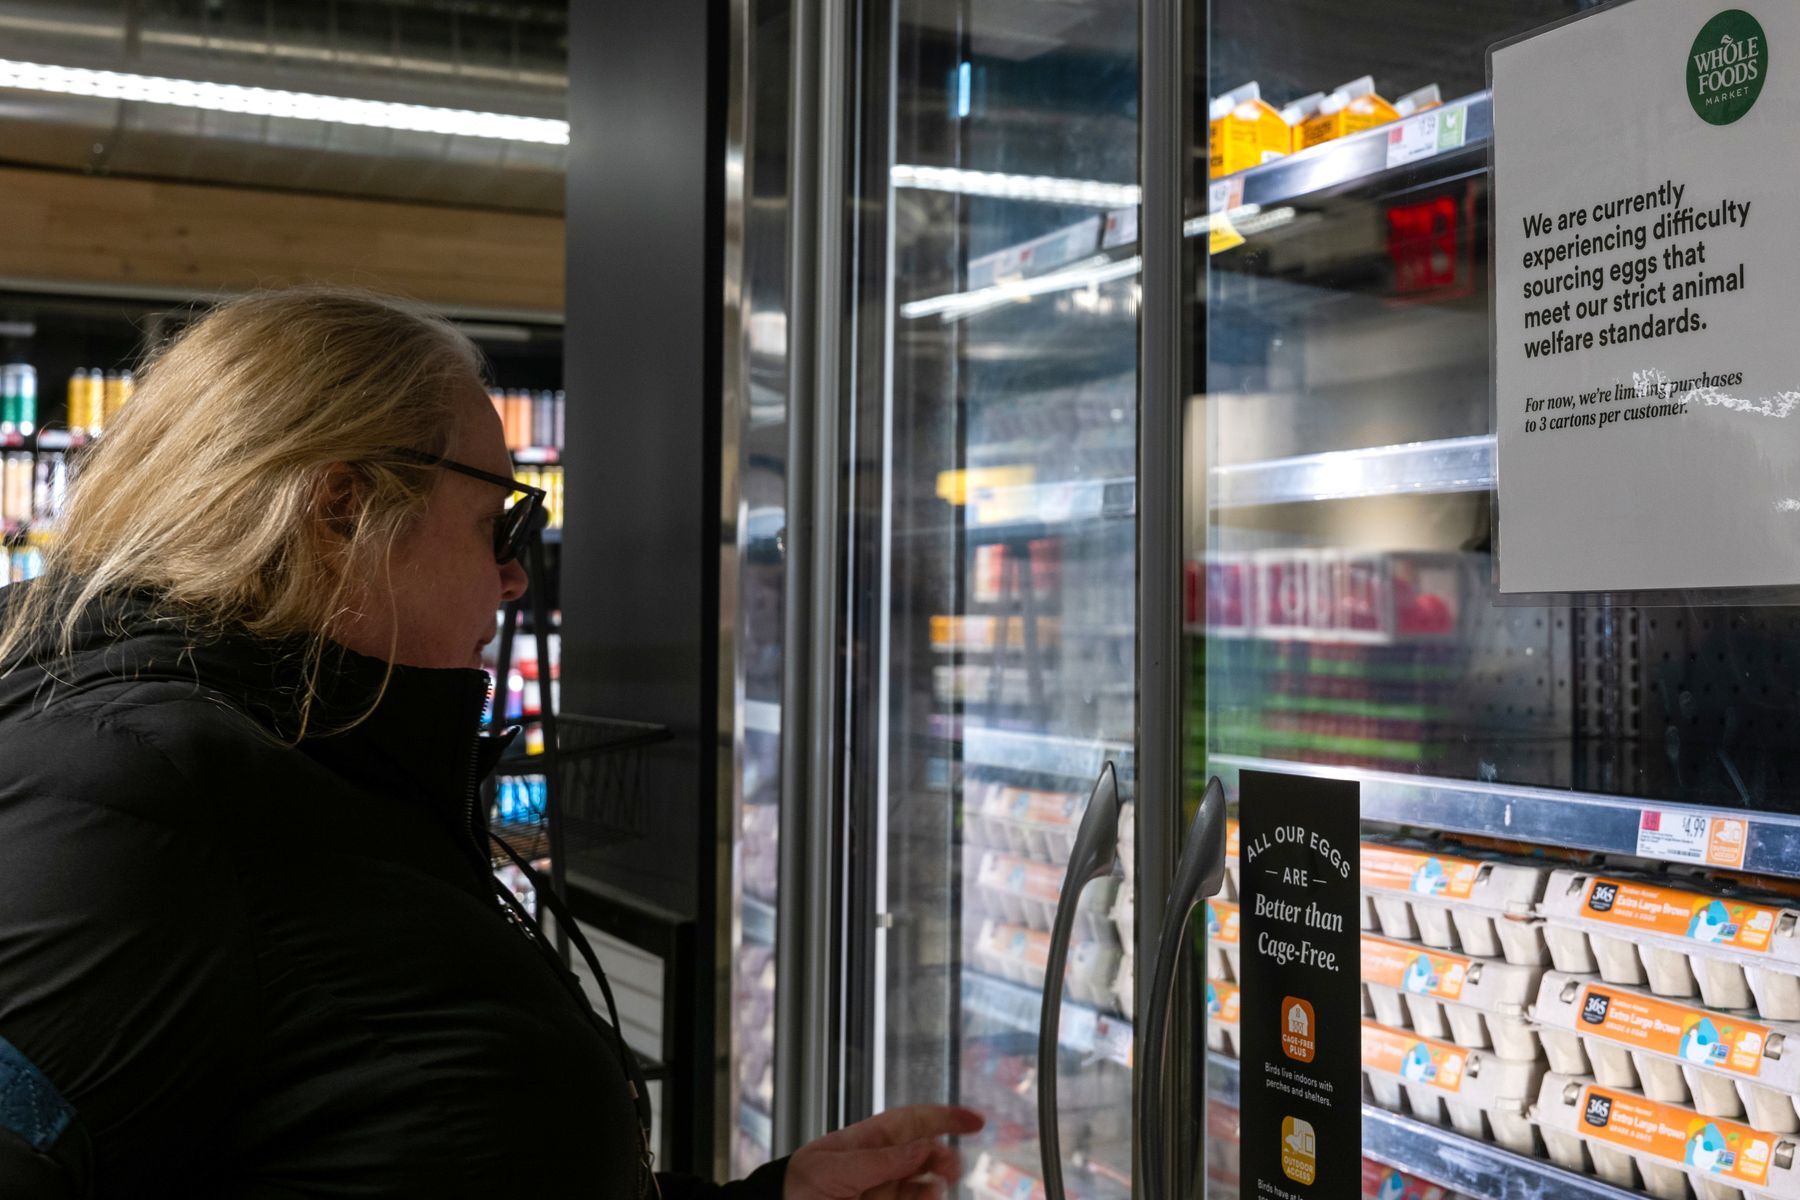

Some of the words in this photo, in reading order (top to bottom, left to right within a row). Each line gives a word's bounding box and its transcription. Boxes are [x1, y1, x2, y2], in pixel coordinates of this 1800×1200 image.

[1693, 34, 1759, 74] WHOLE
[1698, 58, 1758, 96] FOODS
[1705, 86, 1749, 106] MARKET
[1522, 212, 1552, 239] We
[1557, 209, 1587, 231] are
[1593, 180, 1685, 222] currently
[1522, 224, 1646, 270] experiencing
[1653, 199, 1751, 240] difficulty
[1523, 265, 1604, 299] sourcing
[1610, 255, 1658, 286] eggs
[1663, 241, 1706, 271] that
[1524, 300, 1571, 328] meet
[1576, 297, 1608, 320] our
[1613, 281, 1665, 313] strict
[1672, 263, 1745, 301] animal
[1524, 329, 1594, 359] welfare
[1599, 307, 1707, 347] standards.
[1525, 397, 1544, 413] For
[1547, 393, 1577, 410] now,
[1579, 387, 1612, 405] we're
[1669, 371, 1743, 398] purchases
[1525, 418, 1537, 433] to
[1539, 416, 1547, 432] 3
[1549, 411, 1596, 430] cartons
[1599, 409, 1621, 428] per
[1623, 402, 1689, 423] customer.
[1247, 832, 1272, 863] ALL
[1274, 825, 1305, 844] OUR
[1309, 831, 1351, 879] EGGS
[1282, 866, 1308, 888] ARE
[1592, 886, 1615, 903] 365
[1616, 894, 1638, 909] Extra
[1639, 898, 1662, 914] Large
[1662, 902, 1690, 918] Brown
[1255, 893, 1302, 924] Better
[1305, 901, 1343, 933] than
[1258, 931, 1340, 972] Cage-Free.
[1585, 997, 1608, 1015] 365
[1609, 1007, 1630, 1022] Extra
[1630, 1013, 1653, 1030] Large
[1653, 1018, 1681, 1035] Brown
[1282, 1033, 1314, 1050] CAGE-FREE
[1289, 1044, 1307, 1058] PLUS
[1264, 1061, 1281, 1076] Birds
[1281, 1067, 1293, 1080] live
[1293, 1071, 1318, 1088] indoors
[1319, 1080, 1334, 1093] with
[1266, 1078, 1291, 1093] perches
[1291, 1087, 1304, 1097] and
[1304, 1090, 1332, 1107] shelters.
[1587, 1098, 1610, 1117] 365
[1611, 1110, 1634, 1126] Extra
[1634, 1116, 1658, 1133] Large
[1658, 1122, 1686, 1140] Brown
[1283, 1155, 1313, 1172] OUTDOOR
[1286, 1167, 1311, 1182] ACCESS
[1257, 1178, 1273, 1194] Birds
[1274, 1185, 1289, 1200] have
